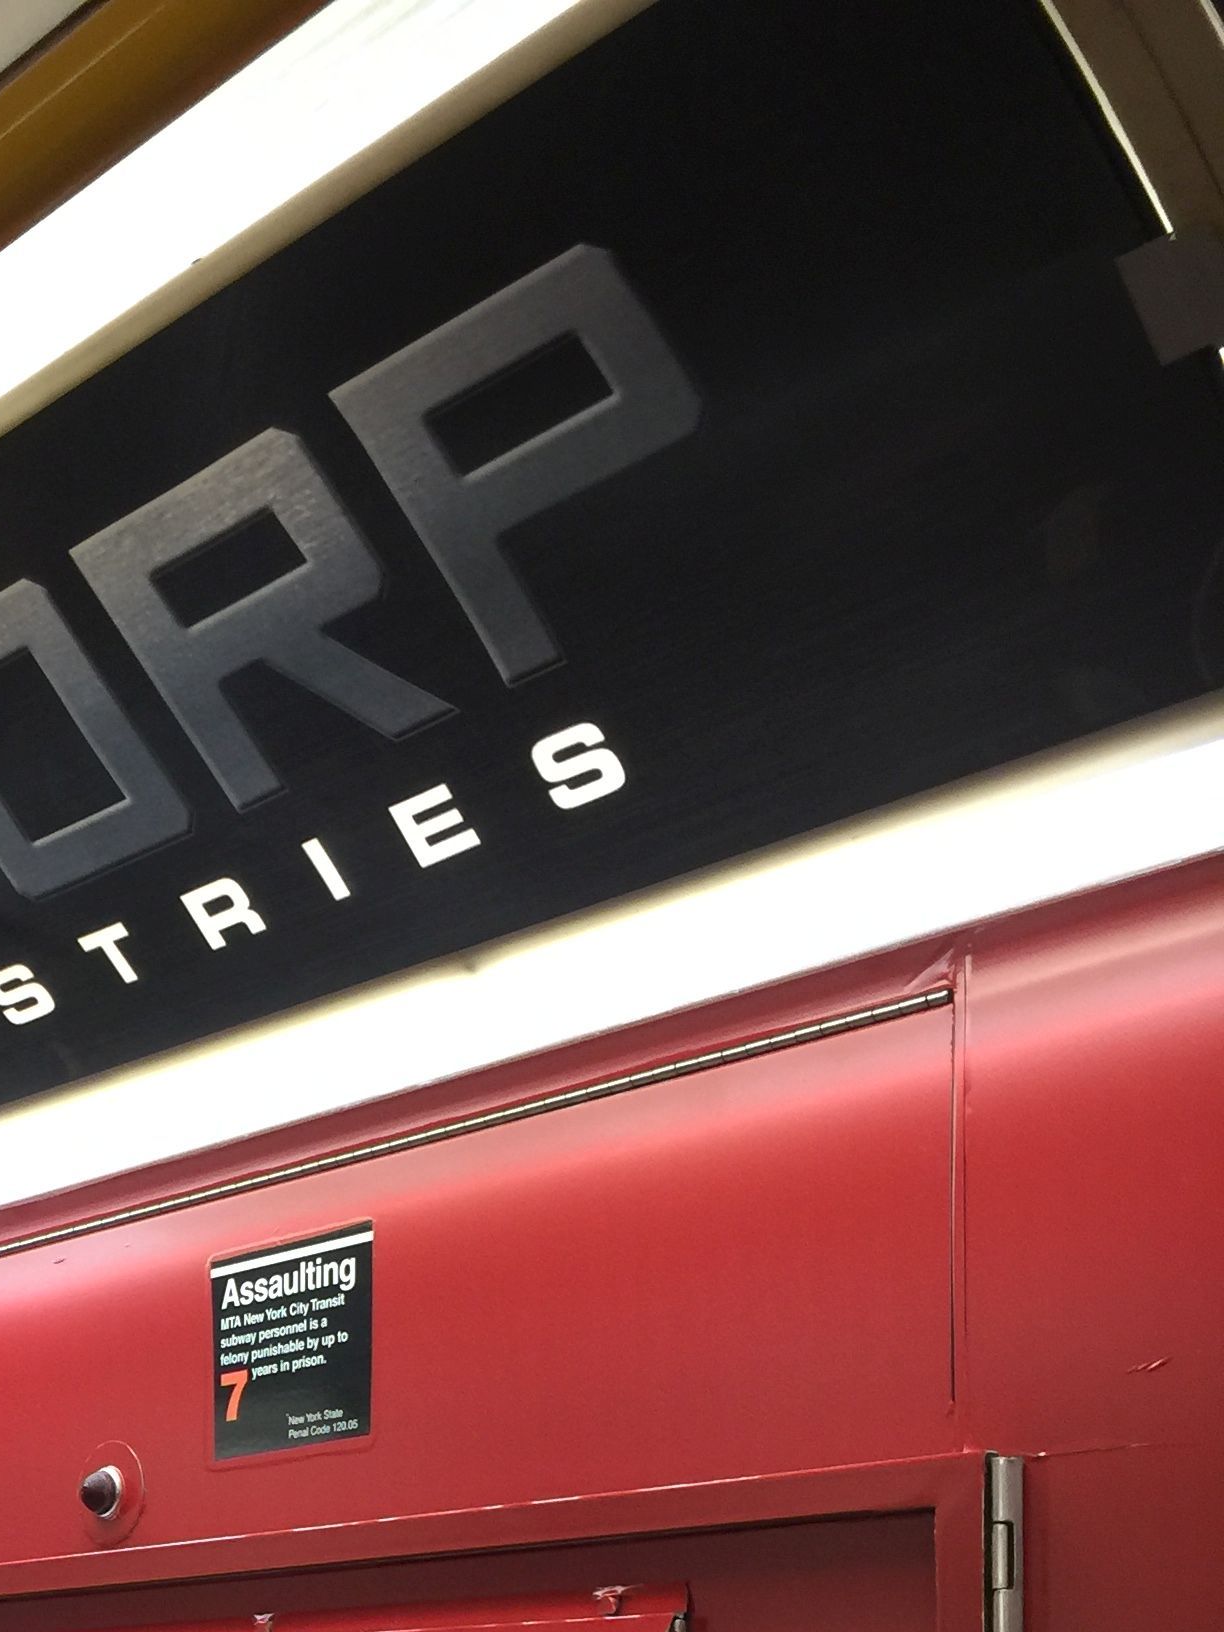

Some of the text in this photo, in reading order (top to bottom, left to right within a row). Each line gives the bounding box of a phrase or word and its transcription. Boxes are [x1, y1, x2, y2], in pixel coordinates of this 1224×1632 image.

[221, 1257, 356, 1310] Assaulting
[220, 1293, 345, 1331] MTA New York City Transit
[220, 1317, 328, 1349] subway personnel is a
[220, 1331, 349, 1366] felony punishable by up to
[220, 1354, 327, 1422] 7 years in prison.
[288, 1427, 309, 1439] Penal
[310, 1424, 331, 1435] Code
[306, 1411, 322, 1422] York
[323, 1409, 343, 1420] State
